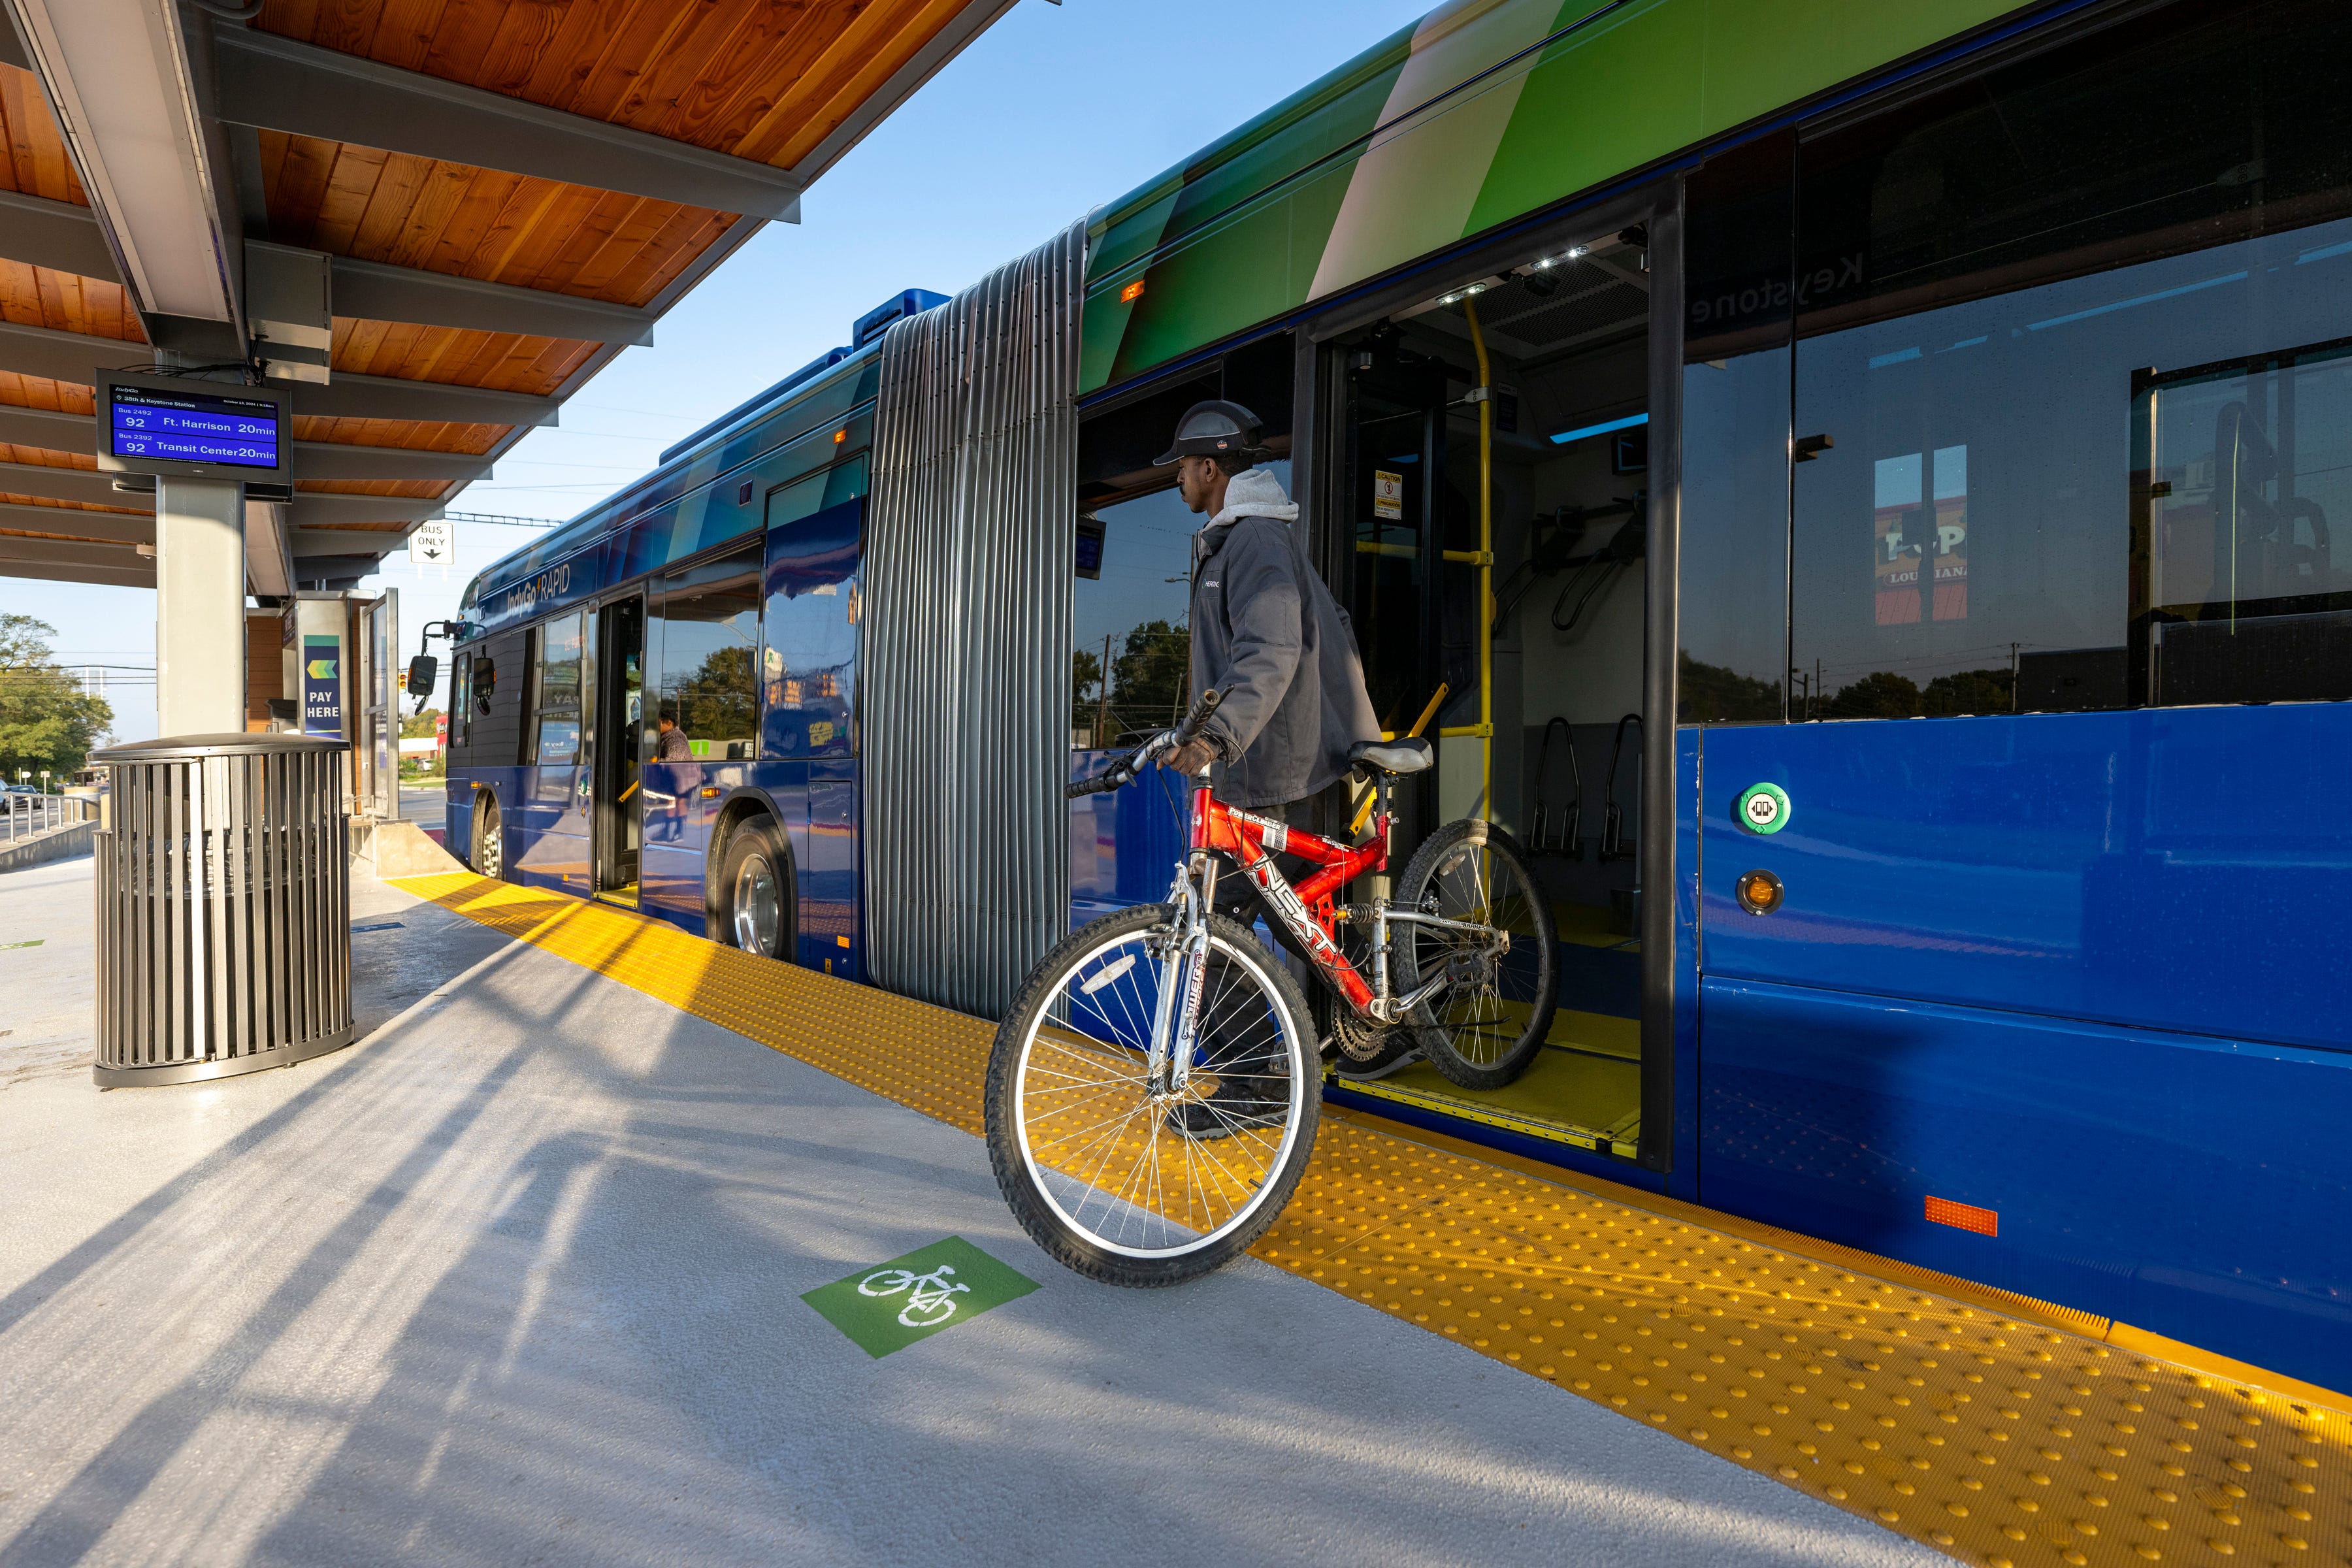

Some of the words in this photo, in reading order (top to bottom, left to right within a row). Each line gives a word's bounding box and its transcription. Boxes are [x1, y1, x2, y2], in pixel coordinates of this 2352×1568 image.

[125, 417, 145, 427] 92
[163, 417, 178, 426] Ft.
[182, 419, 231, 431] Harrison
[238, 424, 275, 435] 20min
[126, 442, 146, 453] 92
[157, 442, 197, 453] Transit
[200, 446, 238, 456] Center
[1381, 474, 1401, 482] CAUTION
[421, 525, 442, 534] BUS
[418, 537, 445, 546] ONLY
[1890, 566, 1967, 584] LOUIAN
[507, 581, 536, 618] IndyGo
[540, 563, 570, 602] RAPID
[310, 692, 332, 702] PAY
[307, 707, 339, 717] HERE
[1253, 854, 1338, 954] NEXT
[1462, 923, 1486, 931] BRAKES
[1184, 967, 1201, 1032] OWER
